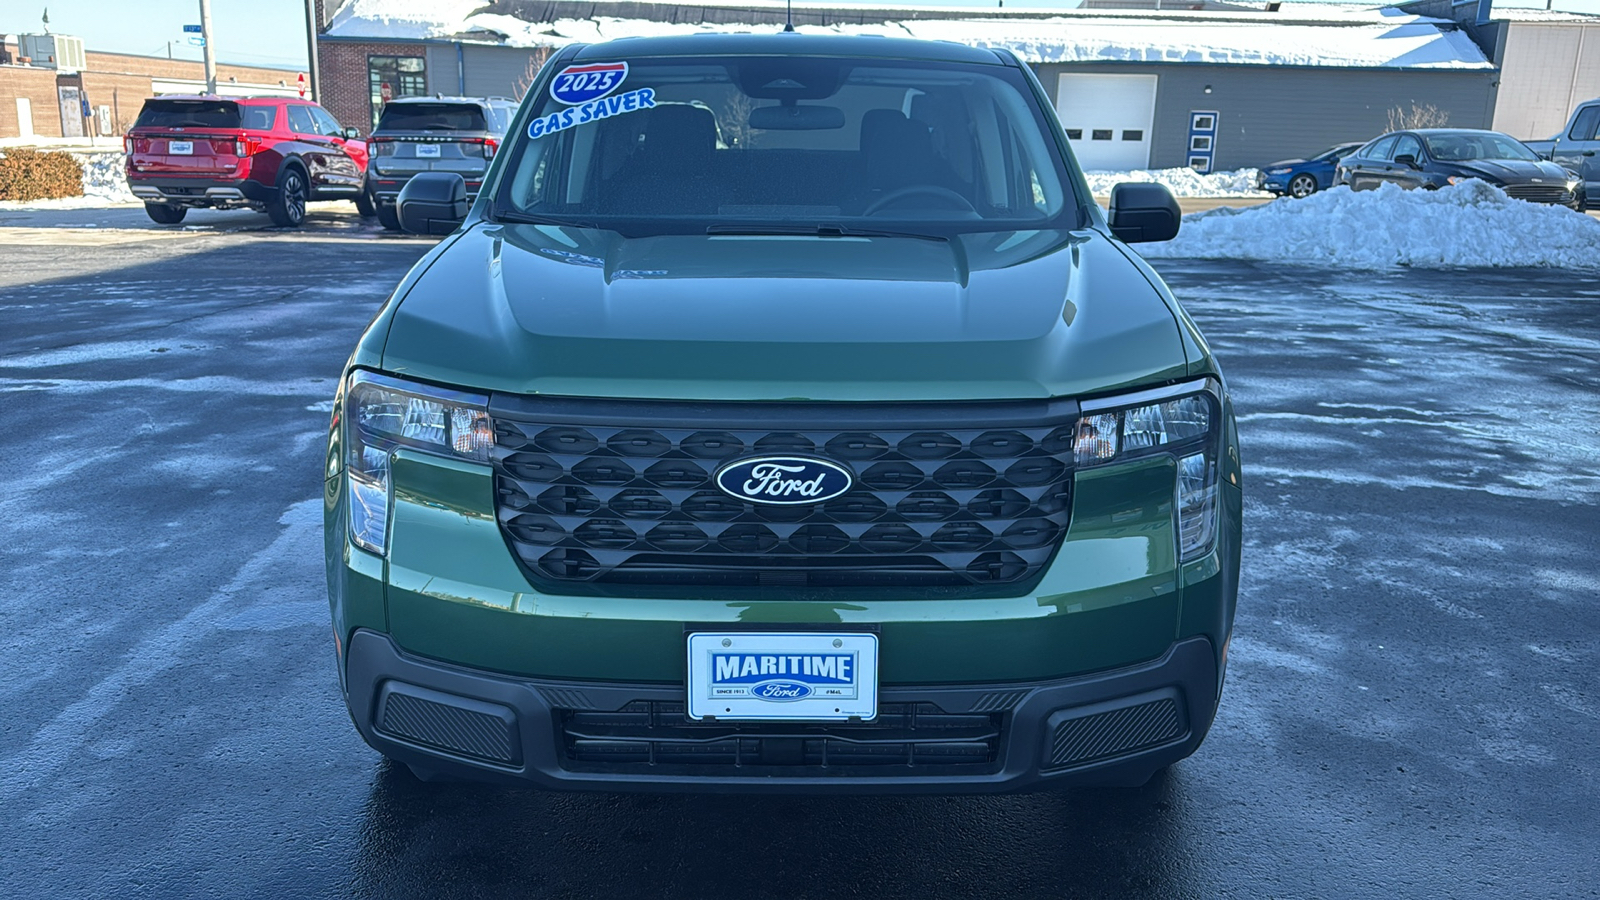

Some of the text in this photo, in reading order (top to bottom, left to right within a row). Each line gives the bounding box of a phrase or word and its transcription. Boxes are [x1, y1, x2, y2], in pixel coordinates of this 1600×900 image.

[557, 72, 616, 92] 2025
[529, 89, 655, 138] GAS SAVER
[743, 463, 826, 496] Ford
[716, 656, 851, 682] MARITIME
[763, 684, 799, 697] Ford
